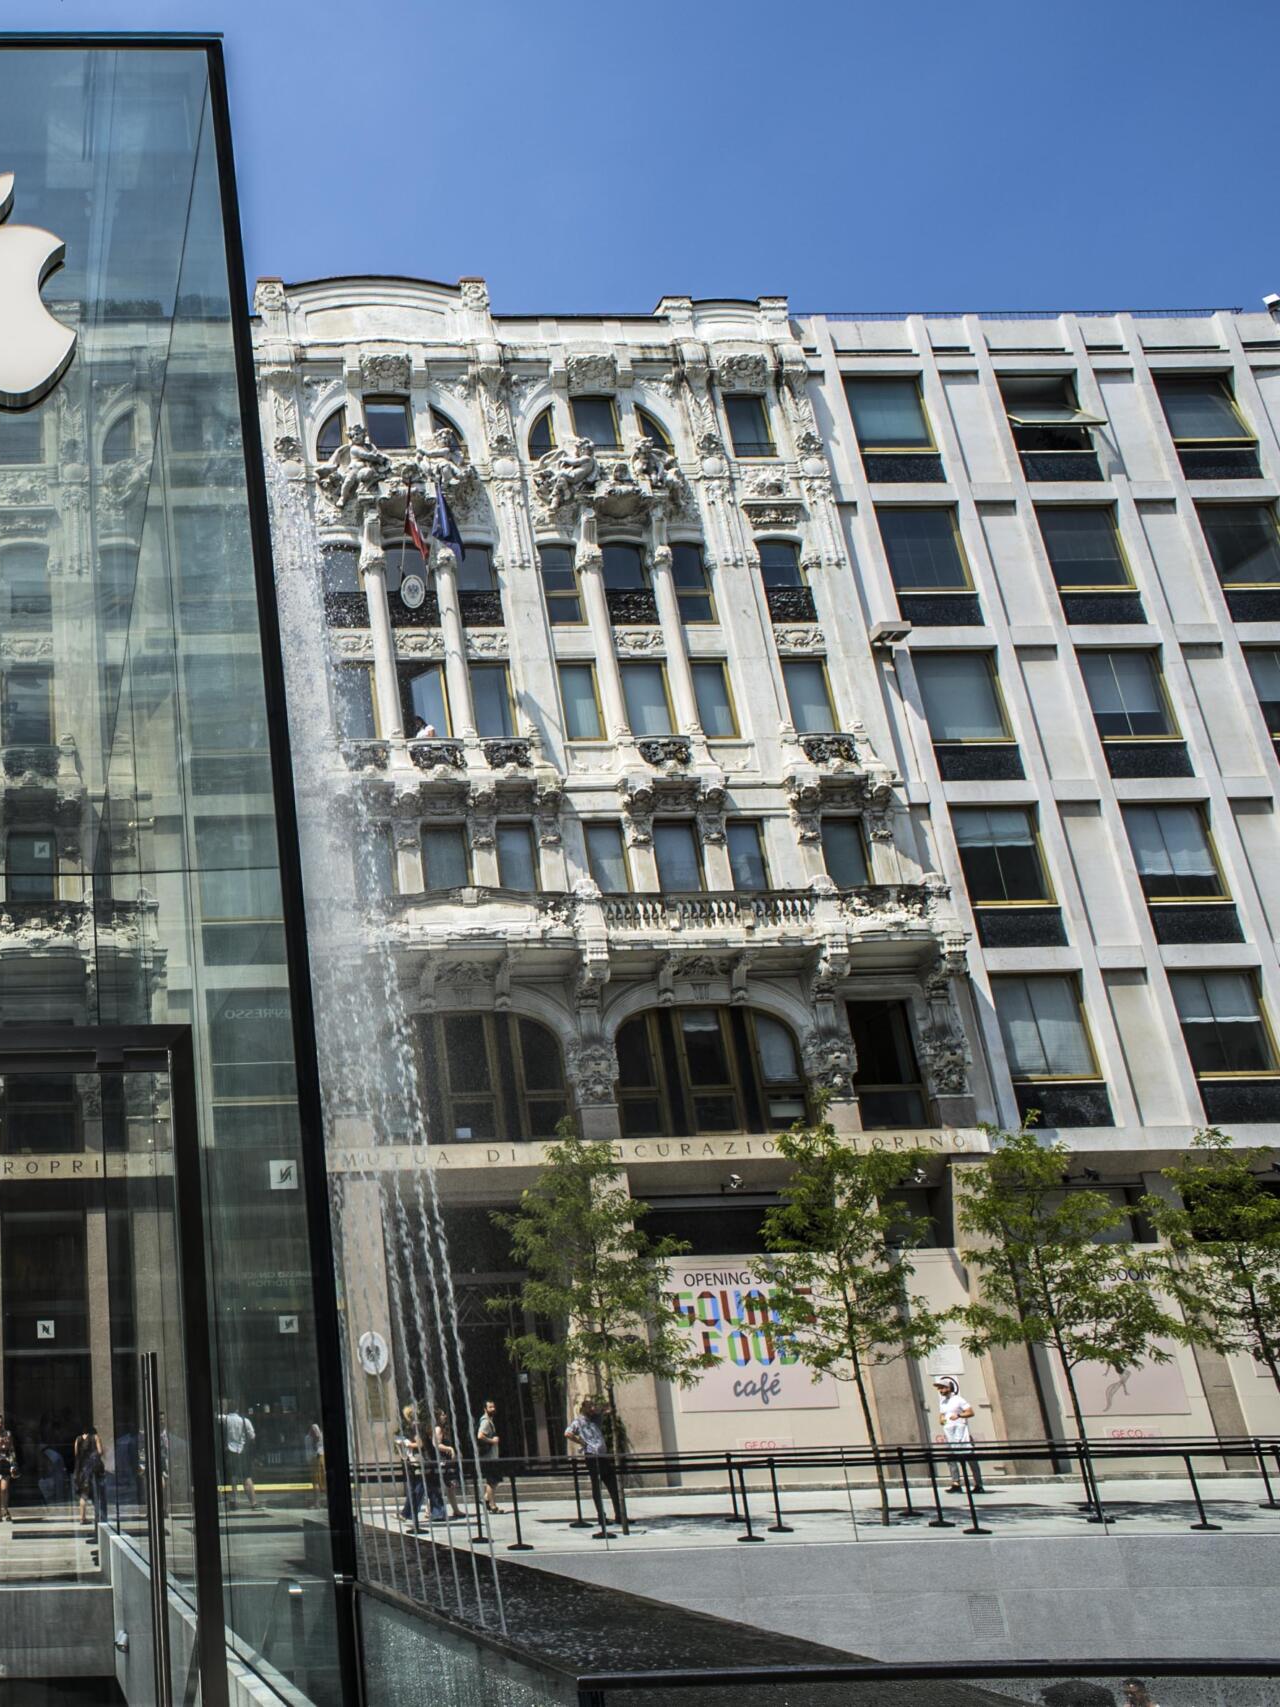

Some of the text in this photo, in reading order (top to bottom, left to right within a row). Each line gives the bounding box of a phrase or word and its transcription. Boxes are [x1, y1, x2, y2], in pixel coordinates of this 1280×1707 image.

[343, 1151, 450, 1167] MUTUA
[487, 1149, 516, 1163] DI
[684, 1270, 787, 1287] OPENING SOO
[733, 1371, 781, 1405] café
